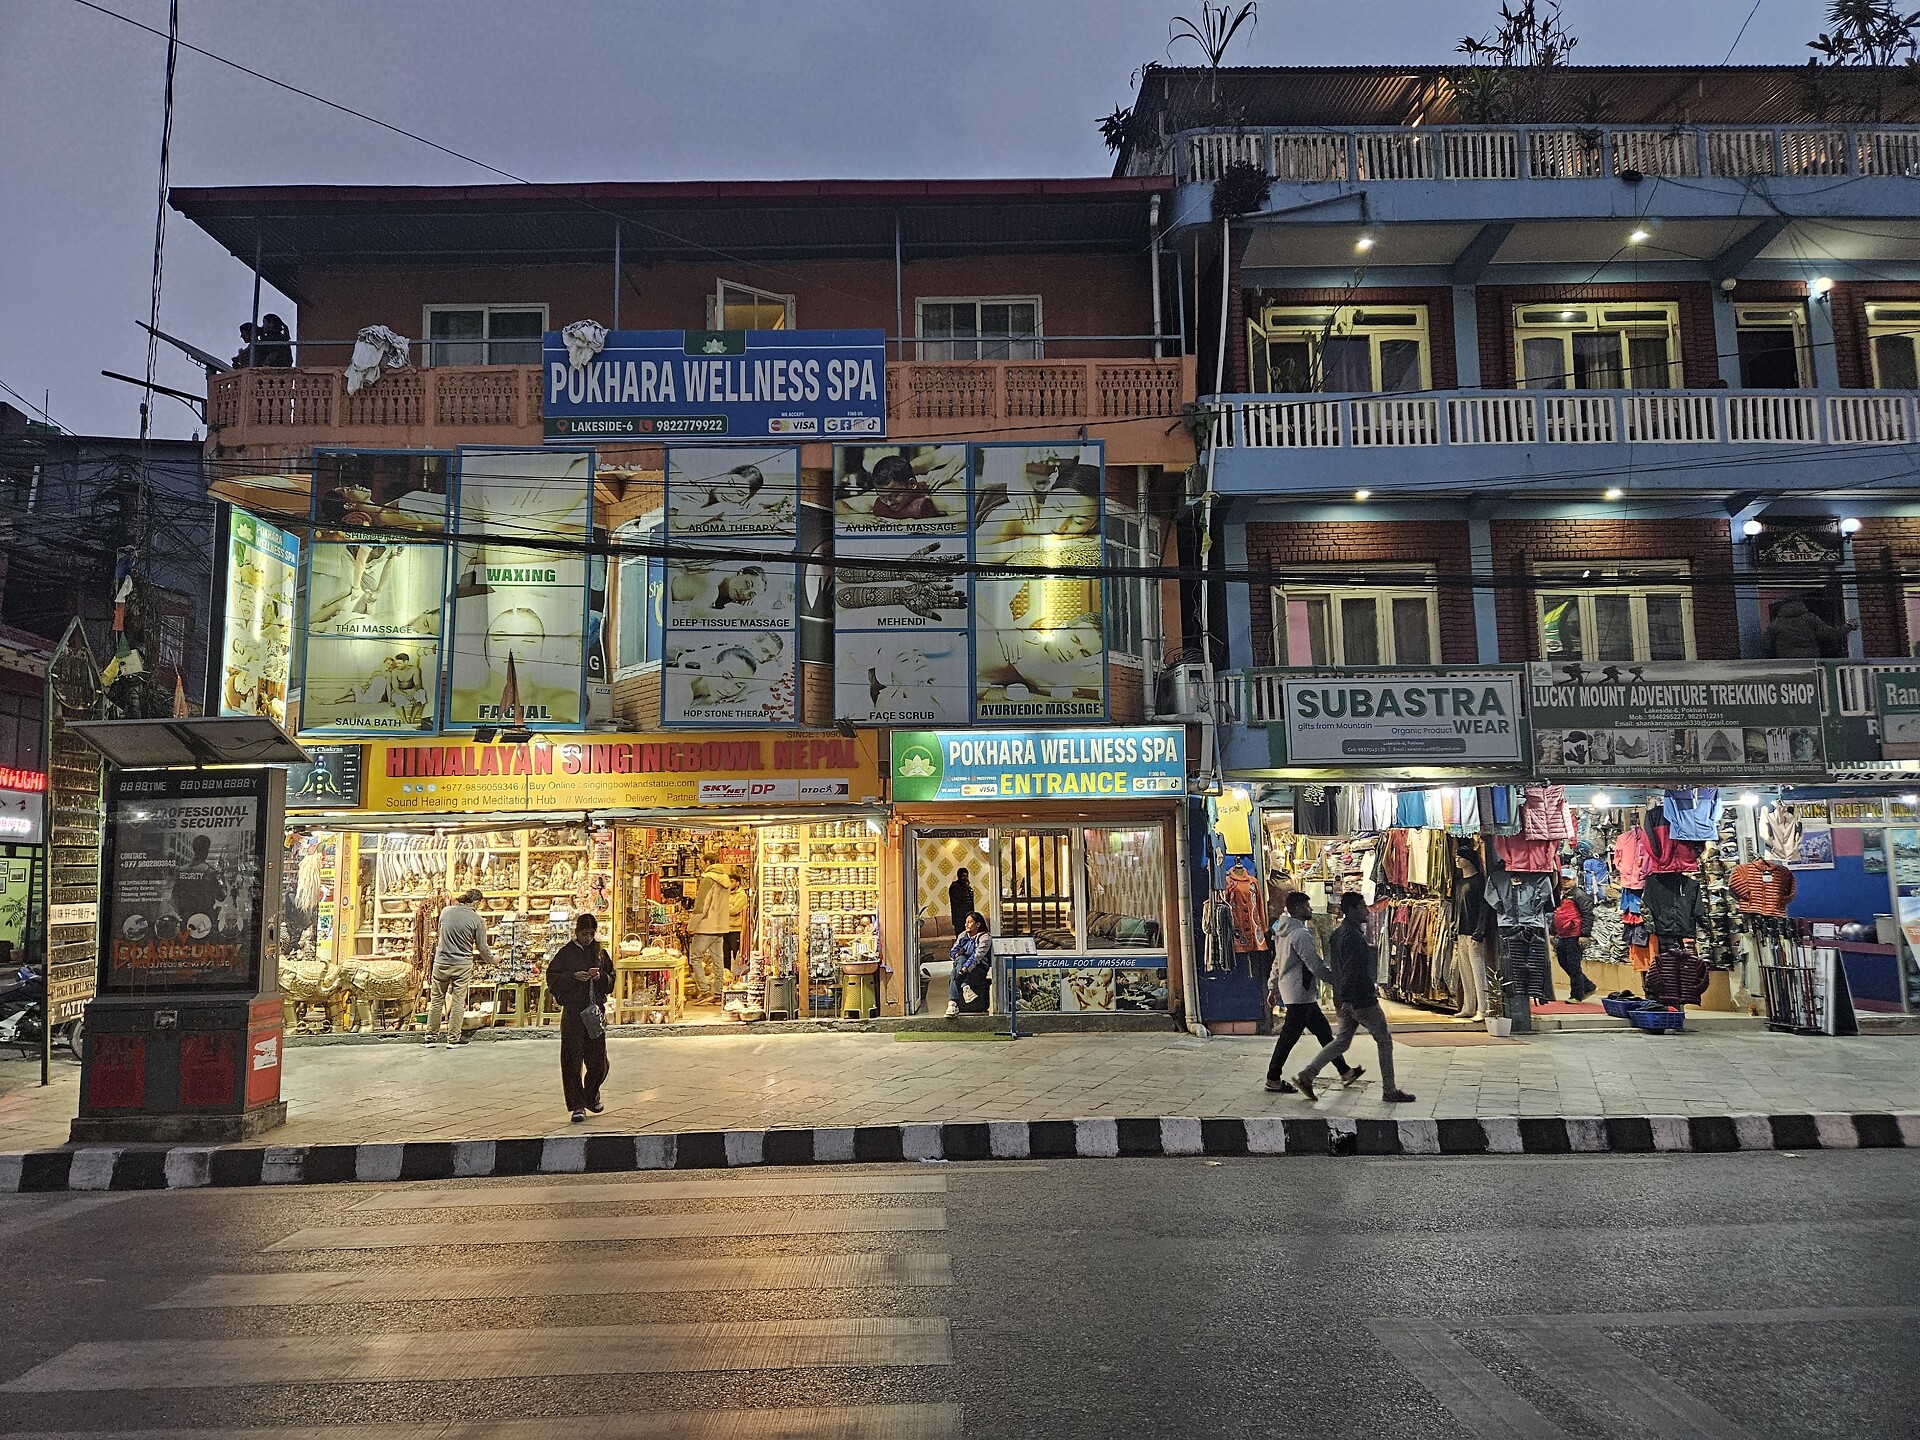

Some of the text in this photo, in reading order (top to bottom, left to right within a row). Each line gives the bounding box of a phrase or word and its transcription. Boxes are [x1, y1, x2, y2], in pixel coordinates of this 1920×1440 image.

[550, 358, 877, 404] POKHARA WELLNESS SPA
[572, 420, 633, 432] LAKESIDE-6
[656, 420, 722, 432] 9822779922
[793, 420, 815, 430] VISA
[688, 524, 776, 532] AROMA THERAPY
[846, 523, 957, 532] AYURVEDIC MASSAGE
[256, 524, 283, 546] POKHARA
[256, 536, 296, 564] WELLNESS SPA
[672, 618, 790, 628] DEEP TISSUE MASSAGE
[877, 618, 926, 626] MEHENDI
[336, 624, 412, 634] THAI MASSAGE
[1532, 684, 1815, 707] LUCKY MOUNT ADVENTURE TREKKING SHOP
[1296, 687, 1506, 719] SUBASTRA
[684, 710, 776, 718] HOP STONE THERAPY
[981, 702, 1100, 716] AYURVEDIC MASSAGE
[869, 711, 935, 720] FACE SCRUB
[335, 718, 402, 728] SAUNA BATH
[1298, 722, 1373, 732] gifts from Mountain
[1453, 720, 1510, 734] WEAR
[786, 731, 814, 739] SINCE
[822, 730, 841, 738] 1990
[1391, 726, 1452, 736] Organic Product
[950, 736, 1178, 766] POKHARA WELLNESS SPA
[386, 744, 553, 777] HIMALAYAN
[562, 740, 764, 775] SINGINGBOWL
[774, 740, 859, 770] NEPAL
[1828, 772, 1876, 780] EKS
[149, 782, 166, 790] TIME
[441, 782, 519, 792] +977-9856059346
[530, 782, 546, 792] Buy
[548, 781, 576, 789] Online
[1001, 772, 1128, 795] ENTRANCE
[386, 796, 418, 808] Sound
[421, 796, 458, 808] Healing
[462, 796, 480, 806] and
[482, 795, 534, 806] Meditation
[536, 794, 556, 804] Hub
[574, 795, 616, 804] Worldwide
[625, 794, 658, 804] Delivery
[667, 792, 698, 802] Partner.
[153, 806, 248, 820] ROFESSIONAL
[1834, 804, 1884, 818] RAFTING
[180, 816, 245, 829] SECURITY
[178, 872, 204, 880] SECURITY
[51, 908, 90, 920] 川味轩中餐厅
[1038, 958, 1136, 968] SPECIAL FOOT MASSAGE
